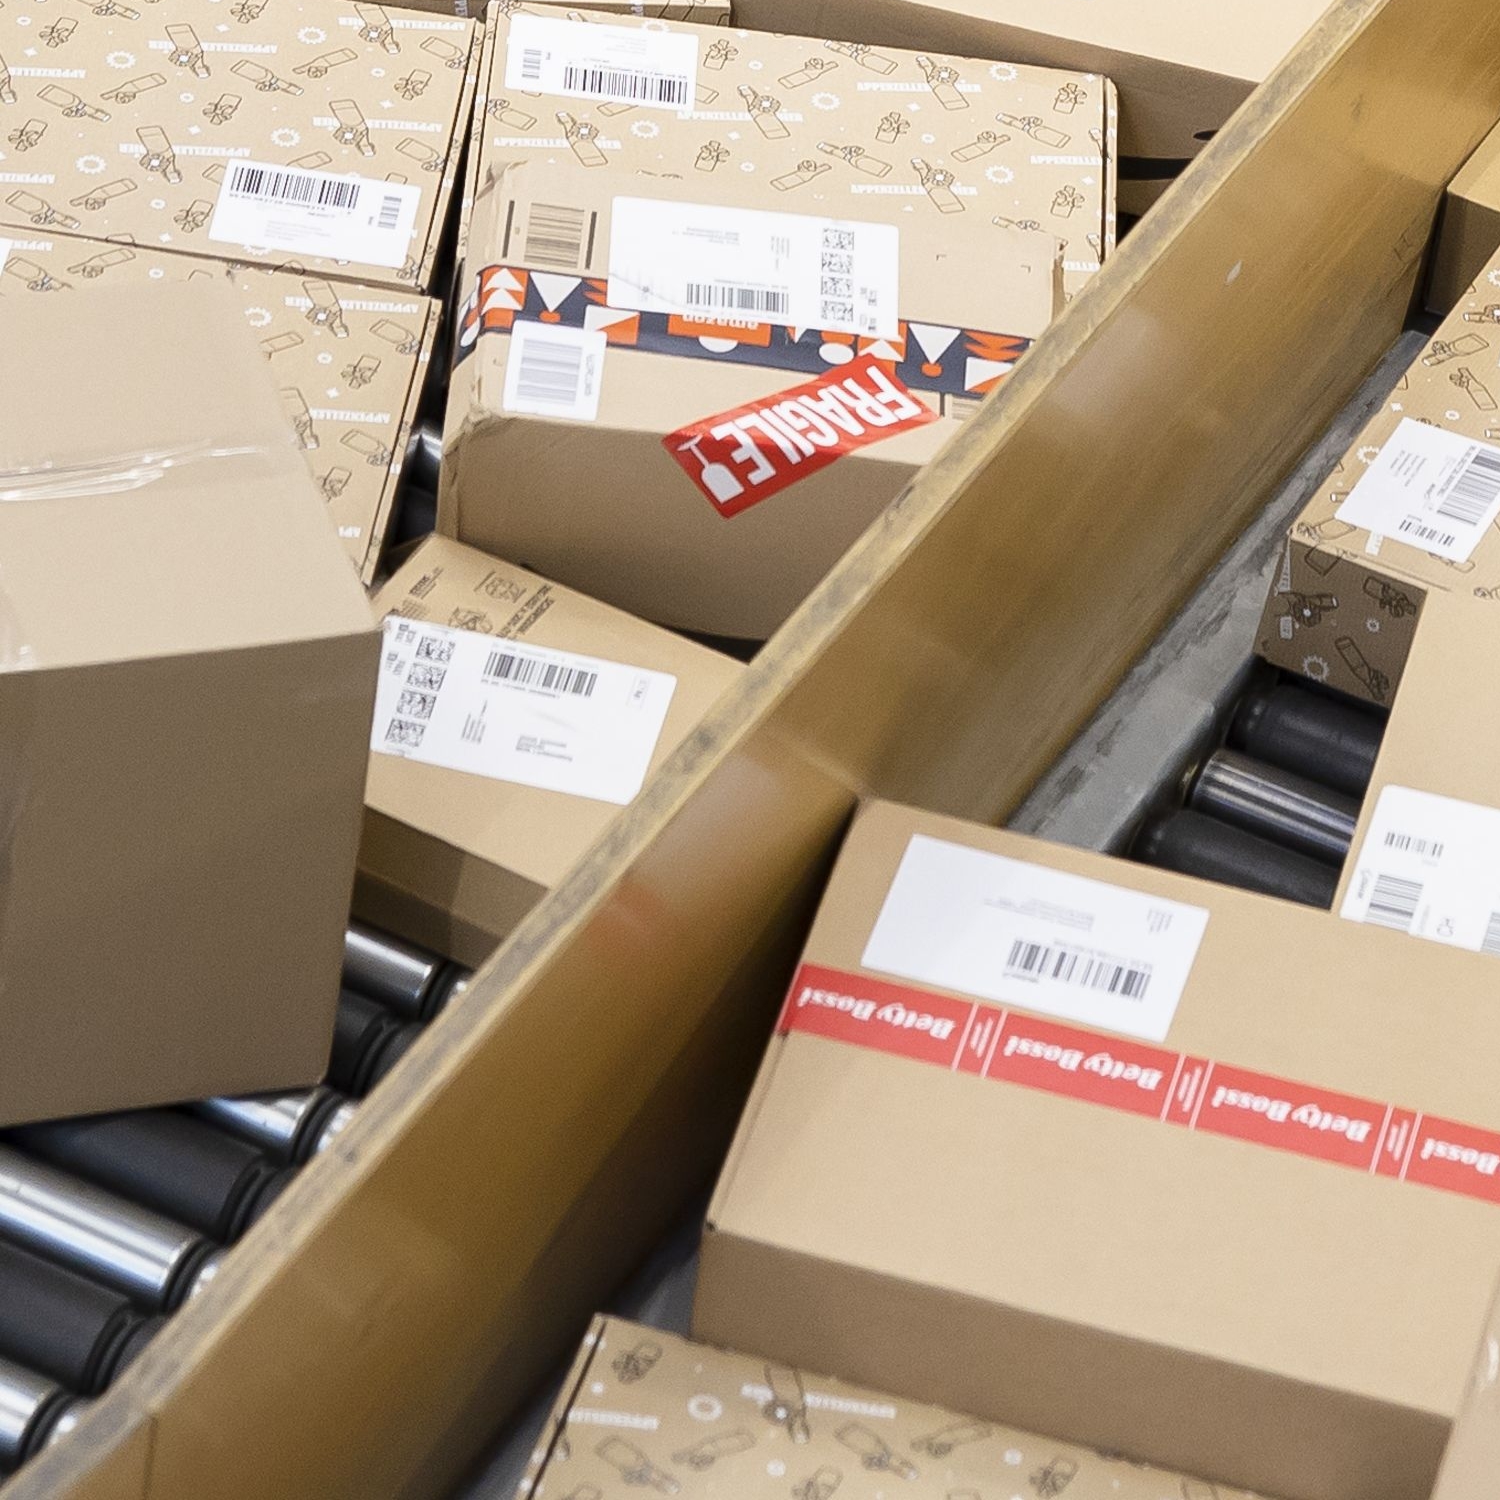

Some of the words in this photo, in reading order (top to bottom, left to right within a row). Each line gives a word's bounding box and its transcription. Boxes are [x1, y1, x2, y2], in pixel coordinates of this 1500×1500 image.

[682, 313, 760, 331] amazon
[709, 365, 922, 486] FRAGILE
[796, 986, 878, 1022] Bossi
[875, 1001, 957, 1041] Betty
[1003, 1034, 1084, 1073] Bossi
[1082, 1052, 1164, 1092] Betty
[1210, 1084, 1292, 1124] Bossi
[1290, 1101, 1372, 1144] Betty
[1419, 1136, 1500, 1177] Bossi
